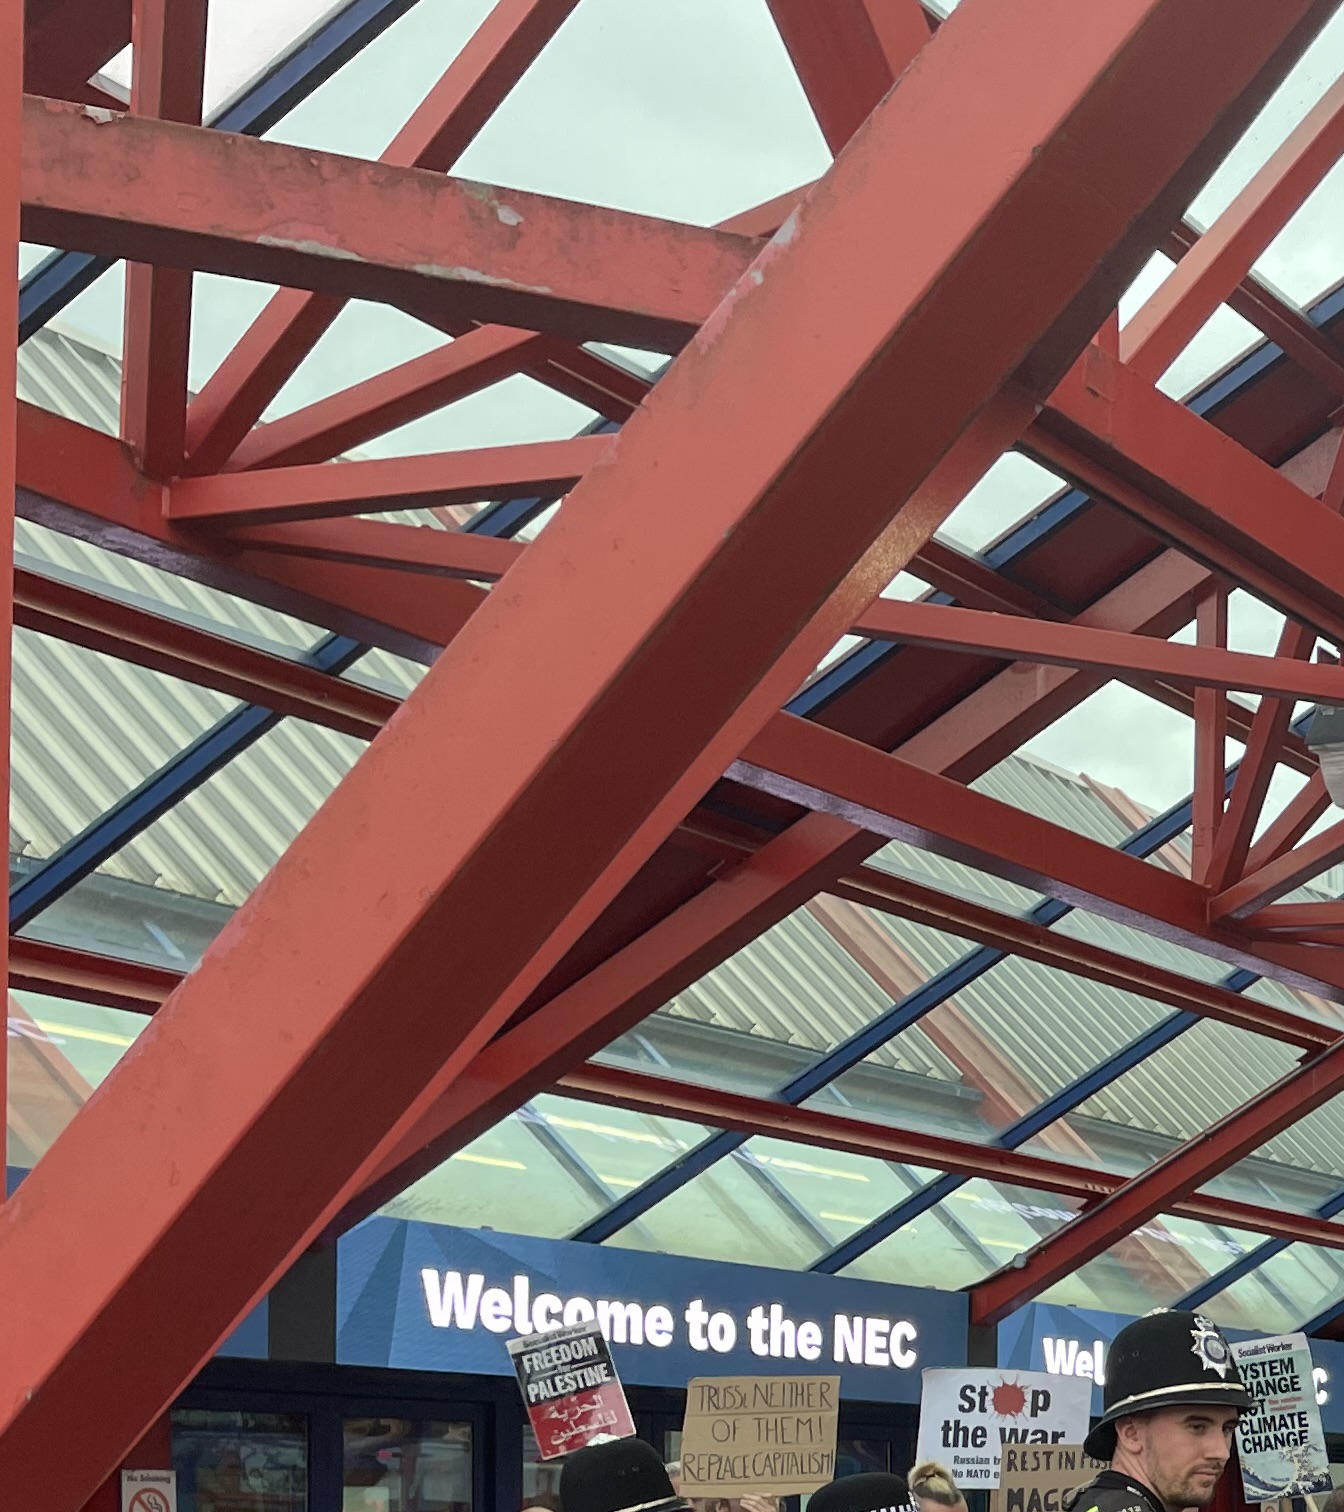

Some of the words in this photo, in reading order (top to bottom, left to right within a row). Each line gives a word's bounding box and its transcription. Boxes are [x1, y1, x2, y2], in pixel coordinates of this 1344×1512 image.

[421, 1268, 673, 1347] Welcome
[685, 1299, 737, 1352] to
[747, 1303, 822, 1361] the
[833, 1313, 918, 1369] NEC
[521, 1336, 599, 1374] FREEDOM
[1238, 1345, 1267, 1359] Socialist
[1267, 1341, 1293, 1354] Worker
[526, 1362, 612, 1403] PALESTINE
[752, 1381, 833, 1410] NEITHER
[1243, 1375, 1302, 1398] HANGE
[712, 1418, 741, 1443] OF
[753, 1415, 824, 1444] THEM!
[941, 1419, 987, 1448] the
[1239, 1411, 1310, 1437] CLIMATE
[1242, 1429, 1309, 1455] CHANGE
[682, 1452, 752, 1482] REPLACE
[953, 1456, 990, 1465] Russian
[966, 1469, 990, 1479] NATO
[1007, 1449, 1054, 1473] REST
[1059, 1450, 1076, 1471] IN
